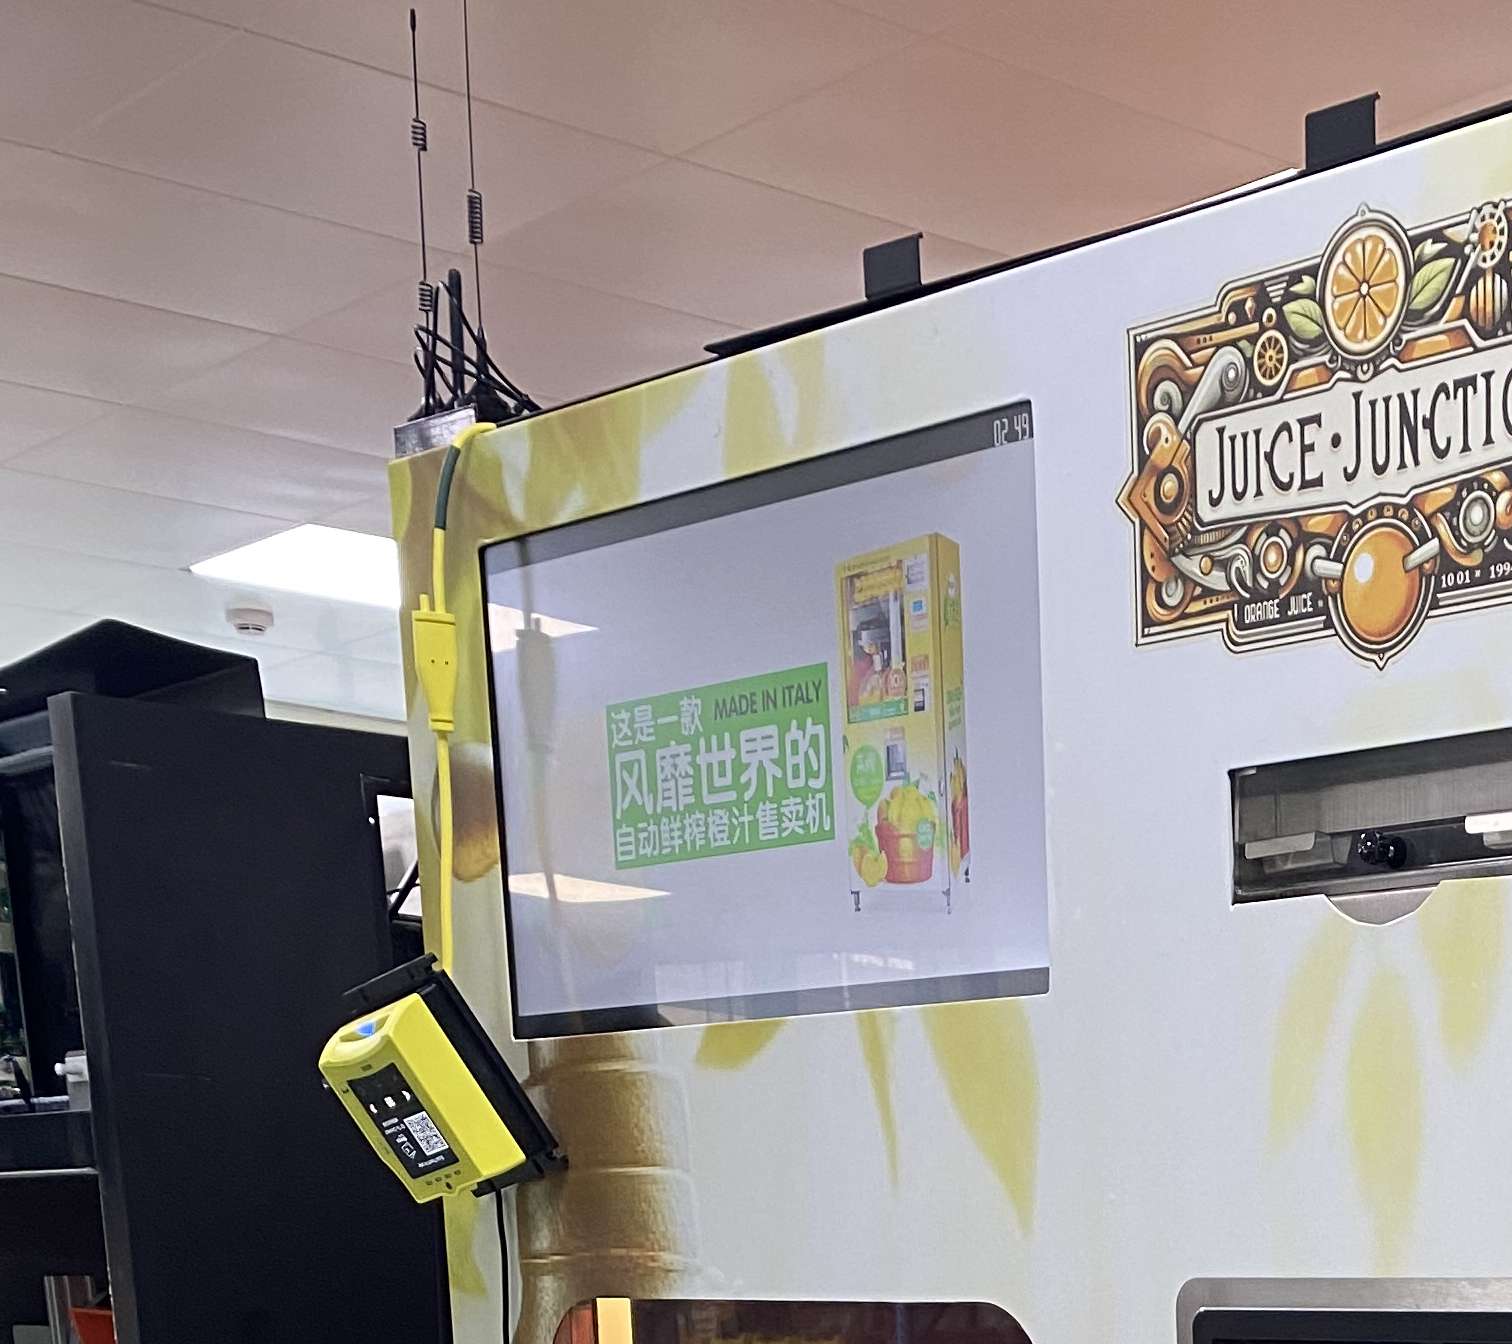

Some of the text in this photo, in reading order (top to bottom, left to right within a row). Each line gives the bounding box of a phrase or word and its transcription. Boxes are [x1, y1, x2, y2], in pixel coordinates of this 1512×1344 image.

[1208, 413, 1323, 508] JUICE
[1244, 592, 1313, 624] ORANGE JUICE
[611, 695, 703, 748] 这是一款
[714, 679, 823, 721] MADE IN ITALY
[615, 717, 826, 820] 风靡世界的
[616, 792, 831, 862] 自动鲜榨橙汁售卖机
